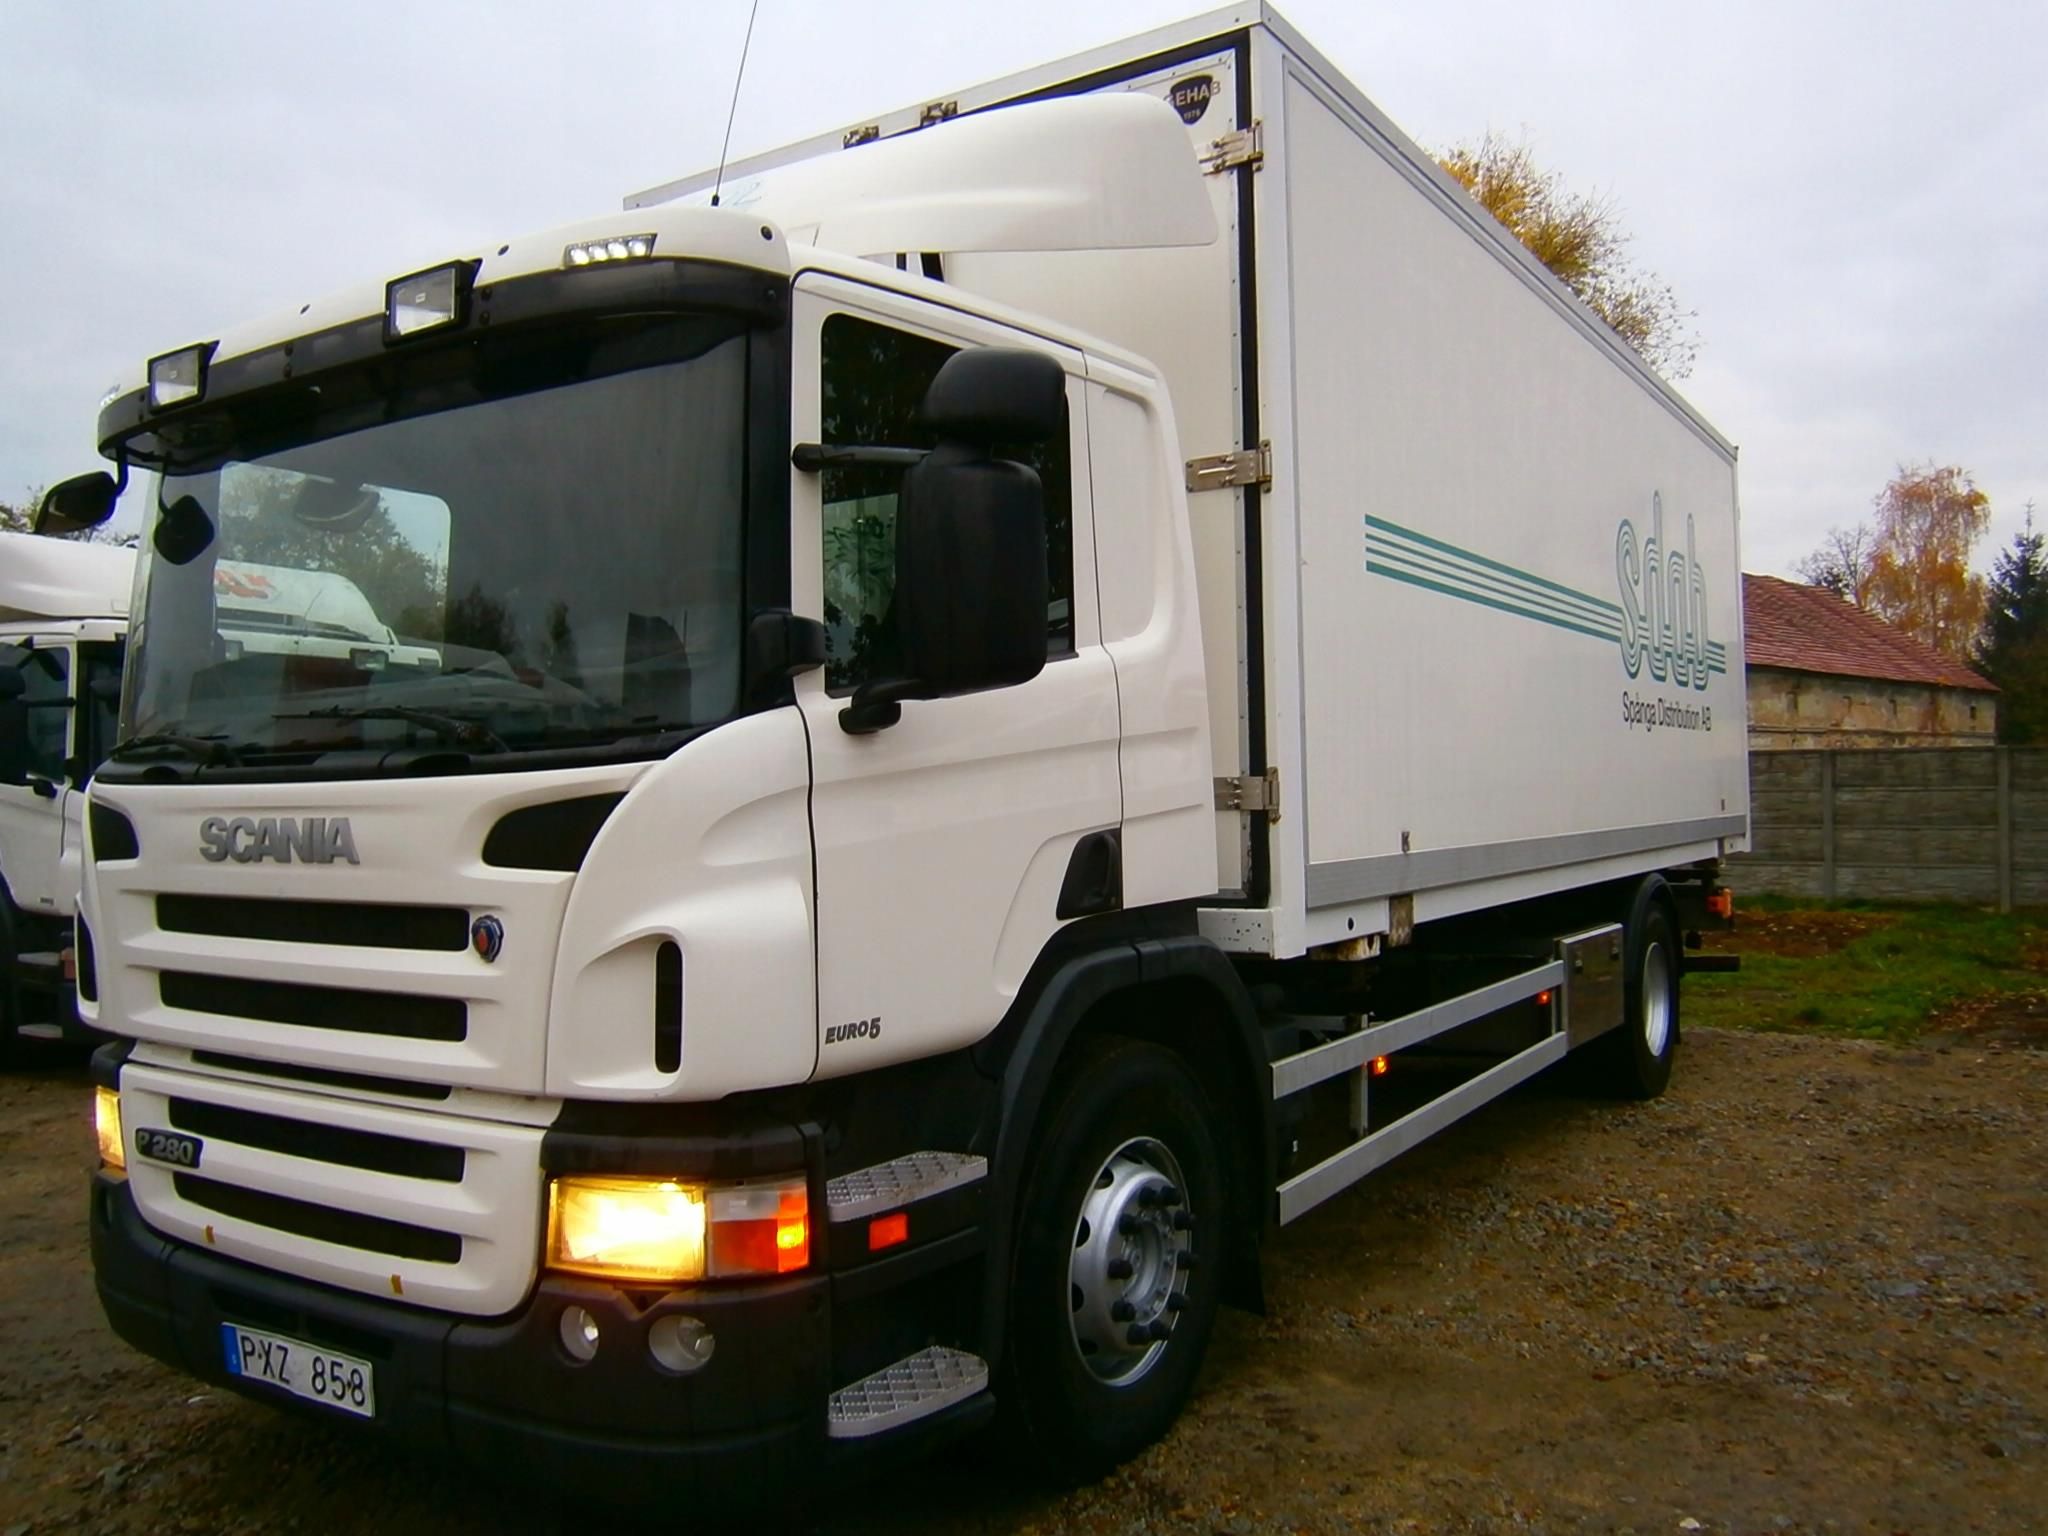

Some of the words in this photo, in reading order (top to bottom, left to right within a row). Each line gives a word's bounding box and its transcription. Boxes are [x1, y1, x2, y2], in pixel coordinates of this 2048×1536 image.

[1658, 698, 1700, 730] Distribution
[1701, 705, 1712, 732] AB
[199, 816, 361, 865] SCANIA
[137, 1130, 150, 1152] P
[152, 1135, 194, 1164] 280
[240, 1334, 291, 1385] PXZ
[311, 1355, 366, 1407] 858
